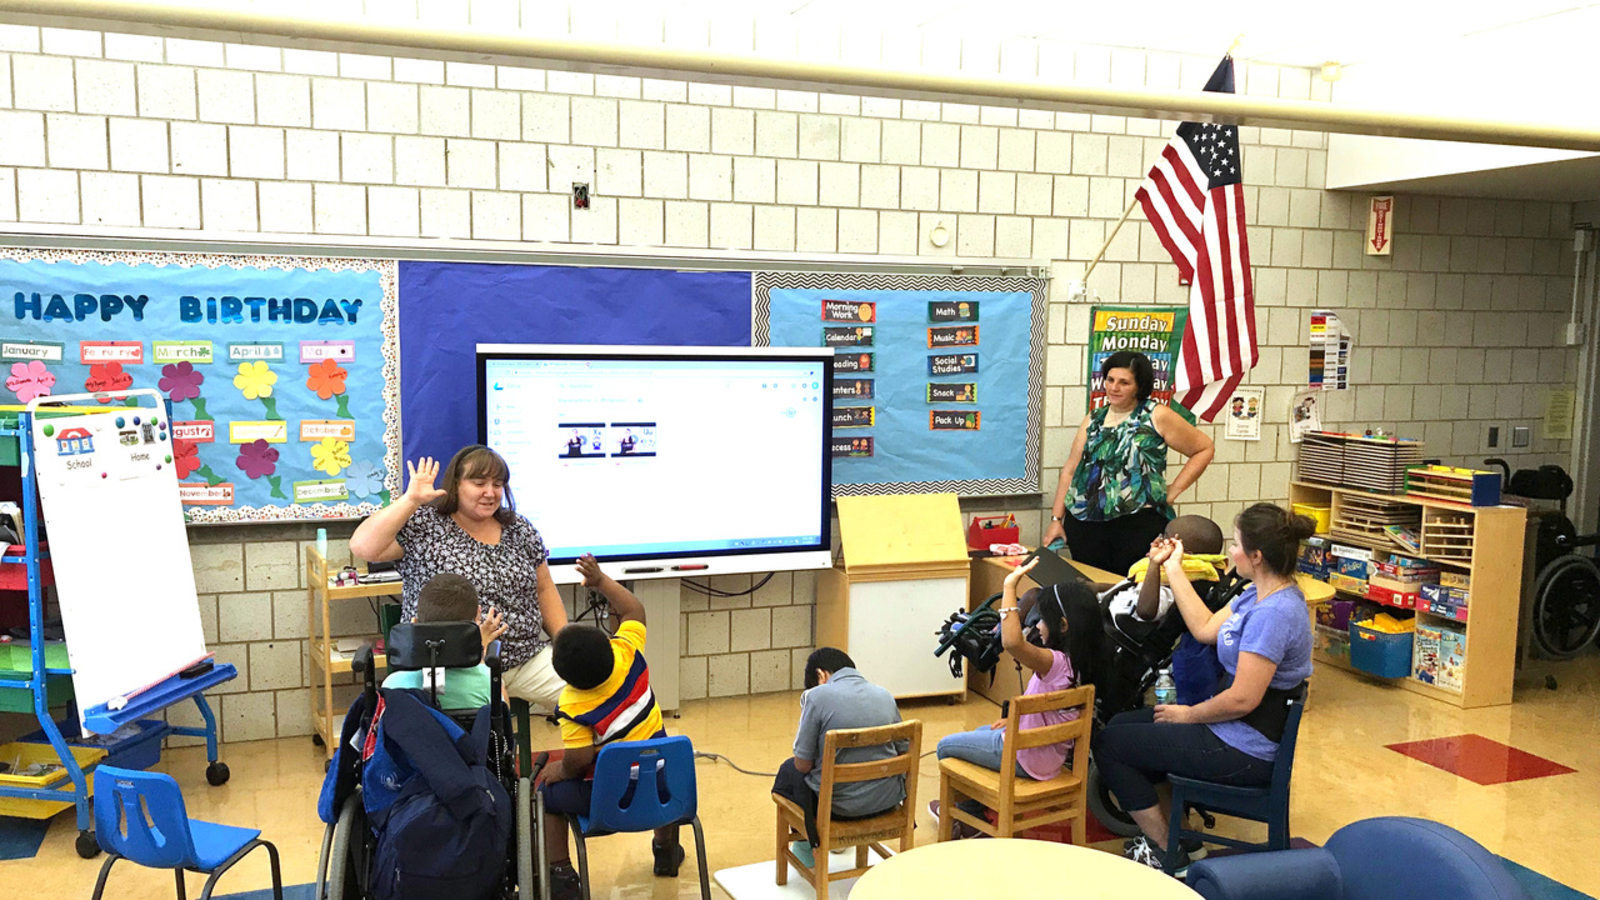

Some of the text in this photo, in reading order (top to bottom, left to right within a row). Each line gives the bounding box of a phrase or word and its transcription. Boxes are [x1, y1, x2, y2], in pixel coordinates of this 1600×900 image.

[14, 292, 362, 325] HAPPY BIRTHDAY
[826, 302, 858, 314] Morning
[832, 310, 853, 319] Work
[1106, 315, 1167, 332] Sunday
[826, 333, 856, 341] Calendar
[933, 333, 955, 342] Music
[1102, 335, 1167, 352] Monday
[3, 345, 48, 357] January
[84, 348, 131, 357] Ferury
[158, 346, 197, 357] March
[232, 346, 261, 358] April
[304, 347, 329, 358] May
[834, 360, 858, 369] eading
[934, 356, 957, 365] Social
[932, 365, 961, 373] Studies
[833, 386, 855, 394] nters
[933, 389, 954, 397] Snack
[833, 413, 852, 421] unch
[935, 415, 965, 426] Pack Up
[173, 426, 199, 438] gust
[303, 426, 339, 435] October
[131, 452, 150, 461] Home
[66, 458, 92, 470] School
[179, 489, 222, 498] November
